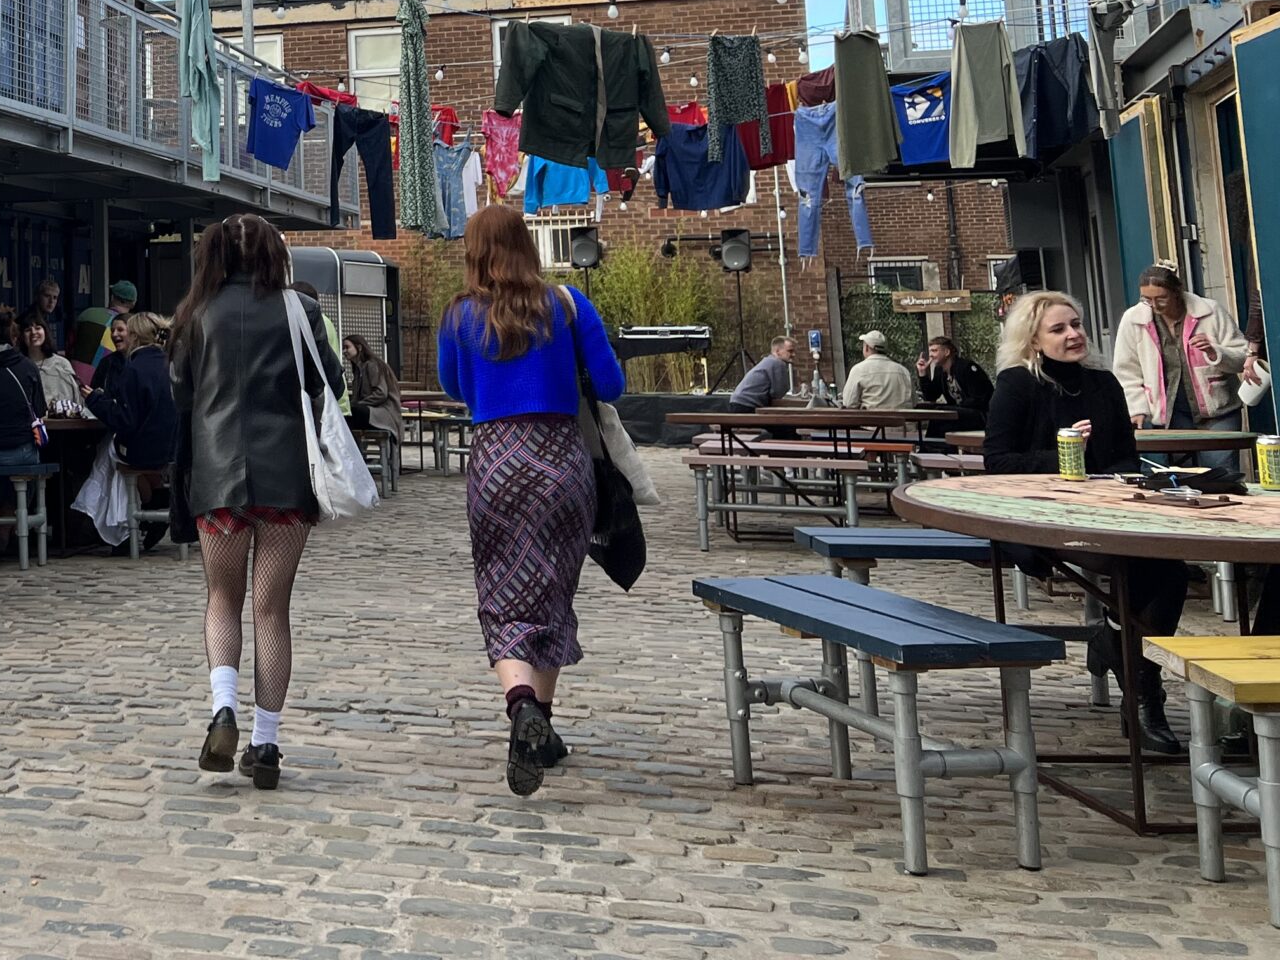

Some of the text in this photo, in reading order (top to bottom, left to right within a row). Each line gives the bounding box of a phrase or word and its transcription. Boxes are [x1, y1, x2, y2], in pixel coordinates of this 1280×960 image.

[264, 94, 292, 113] MEMPHIS
[261, 113, 282, 127] TIGERS
[908, 115, 939, 126] CONVERSE
